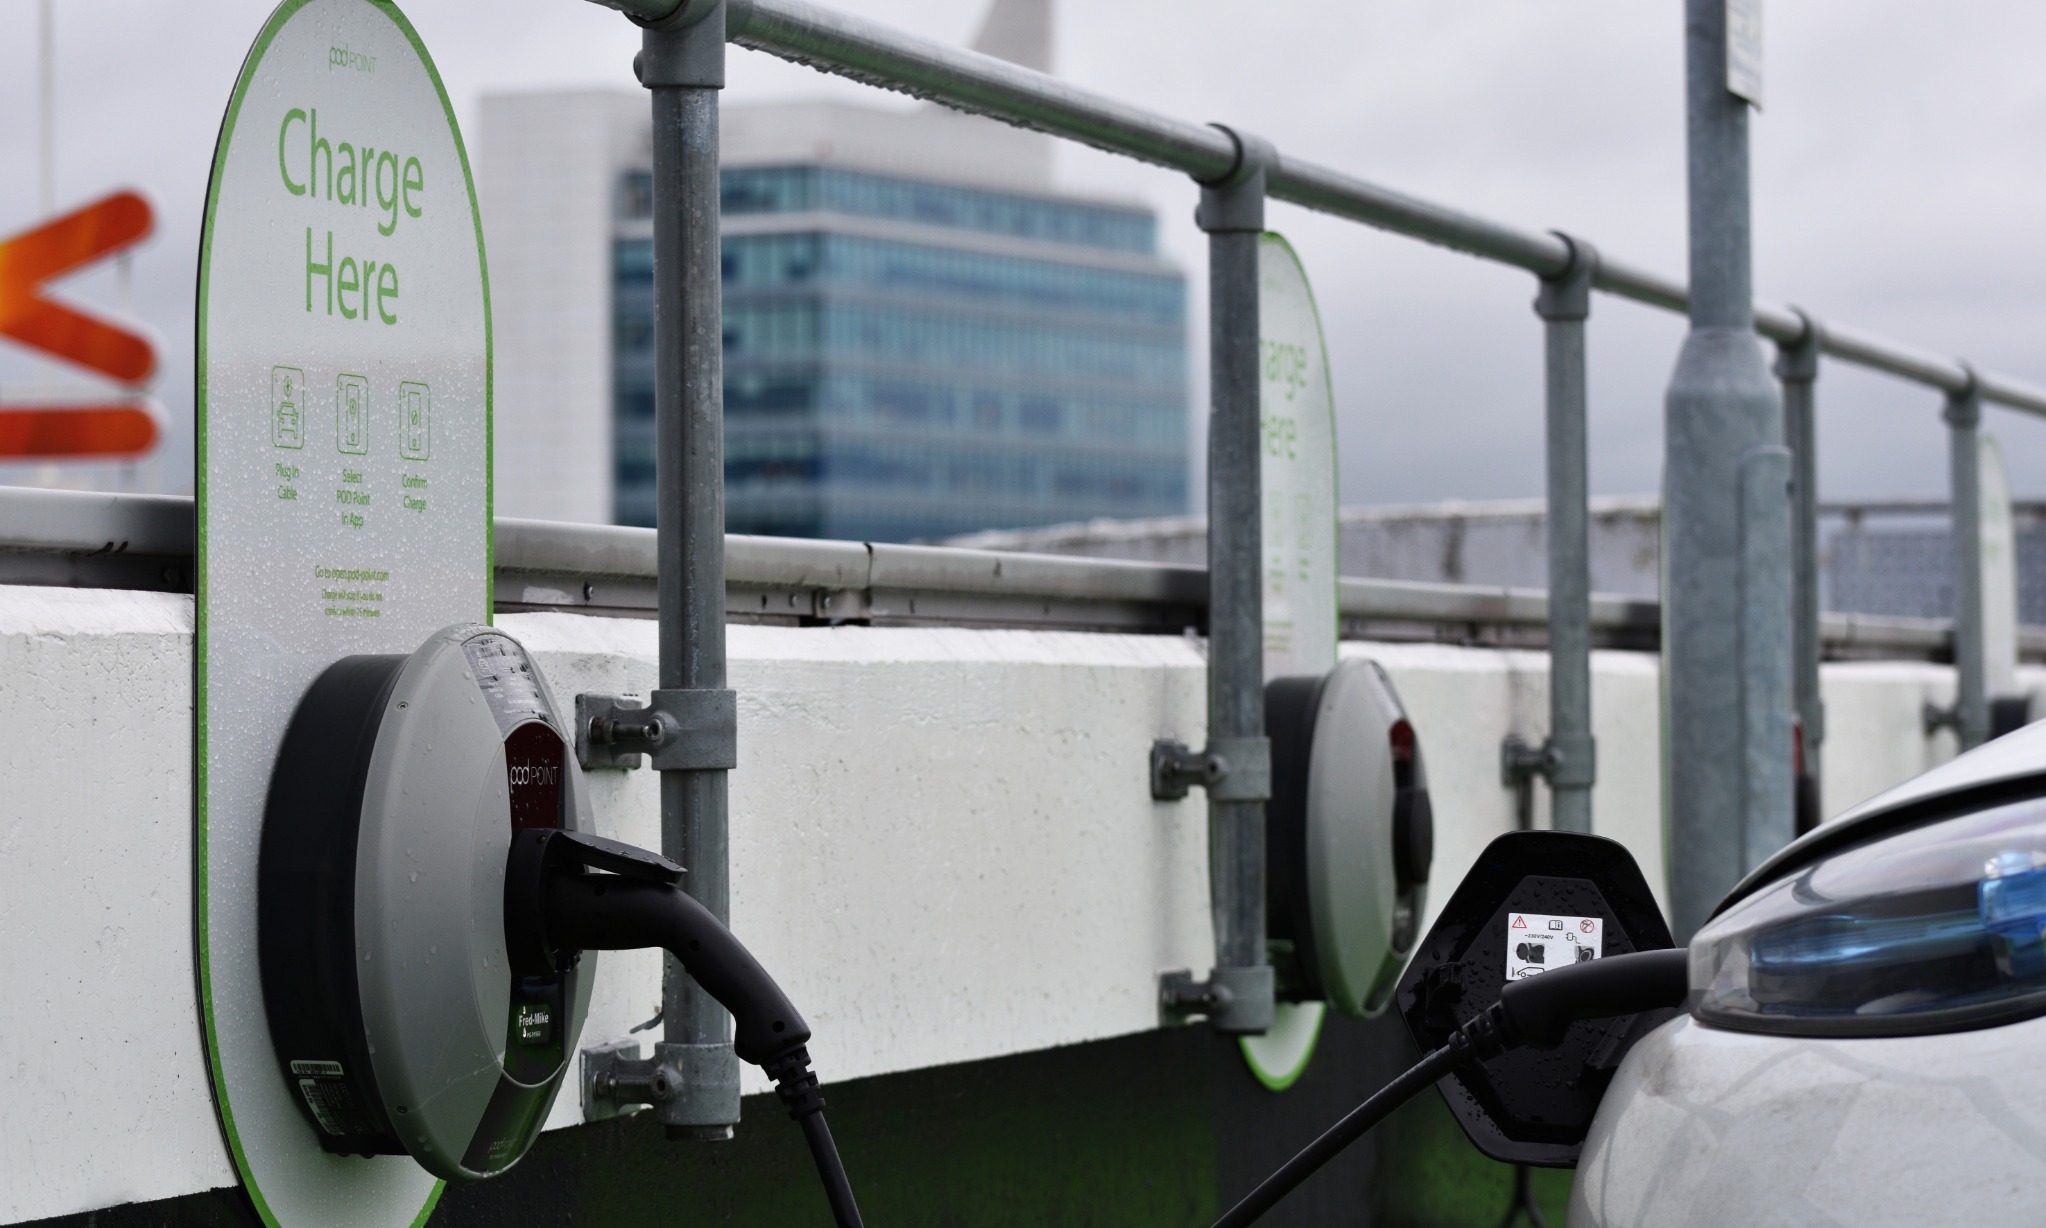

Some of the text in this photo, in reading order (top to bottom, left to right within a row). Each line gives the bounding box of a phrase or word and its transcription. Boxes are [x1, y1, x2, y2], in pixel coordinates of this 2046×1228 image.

[279, 107, 424, 237] Charge
[306, 227, 399, 325] Here
[1260, 338, 1307, 401] arge
[275, 463, 291, 482] Plug
[343, 468, 362, 484] Select
[402, 474, 427, 489] Confirm
[277, 485, 298, 500] Cable
[336, 489, 370, 506] POD Point
[403, 495, 427, 513] Charge
[350, 512, 364, 530] App
[315, 565, 324, 578] Go
[325, 567, 331, 579] to
[518, 1011, 549, 1027] Fred-Mike
